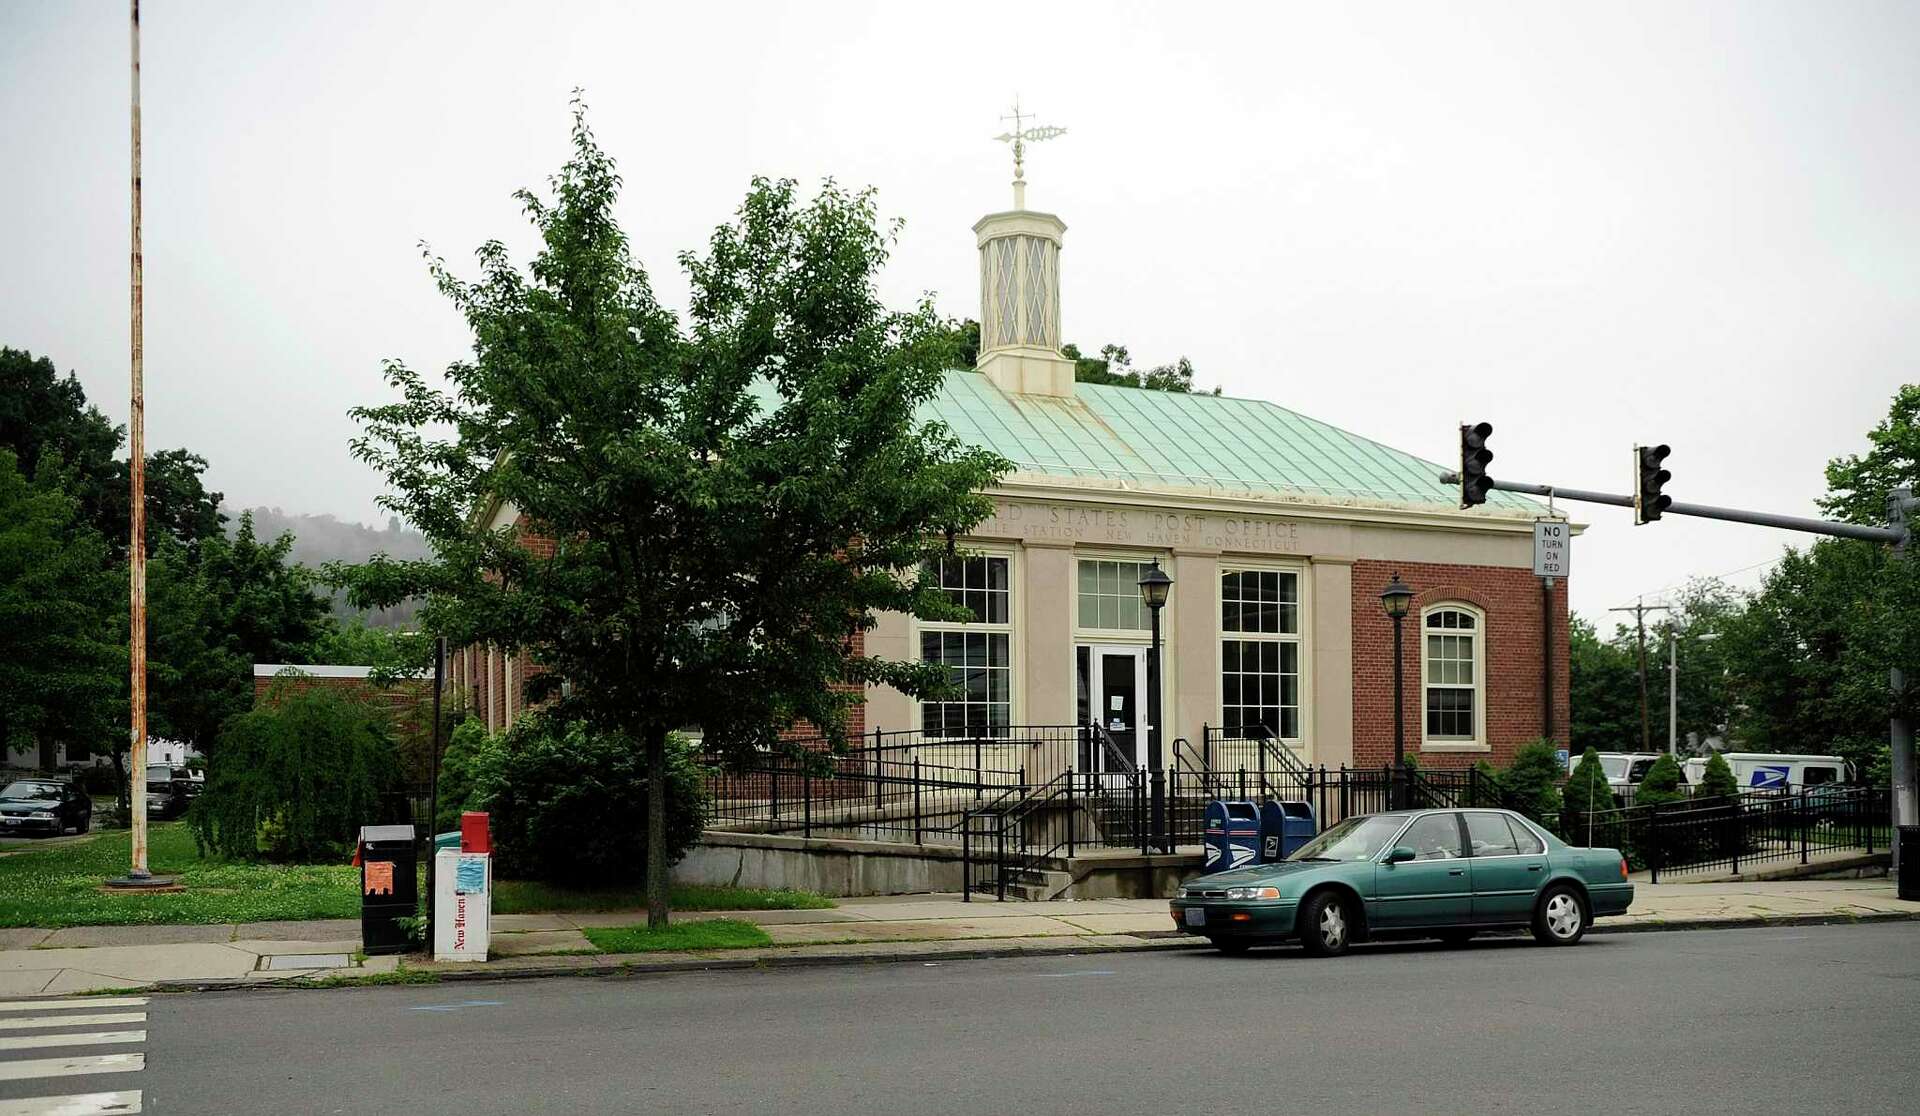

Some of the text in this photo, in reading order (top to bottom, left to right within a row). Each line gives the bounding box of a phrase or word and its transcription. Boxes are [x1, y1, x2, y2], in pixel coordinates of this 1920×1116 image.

[1049, 507, 1297, 539] STATES POST OFFICE
[1023, 523, 1083, 537] STATION
[1106, 529, 1132, 541] NEW
[1146, 532, 1190, 545] HAVEN
[1544, 526, 1561, 537] NO
[1542, 539, 1563, 549] TURN
[1545, 551, 1559, 561] ON
[1543, 563, 1560, 572] RED
[455, 898, 466, 927] Haven
[454, 930, 465, 950] New
